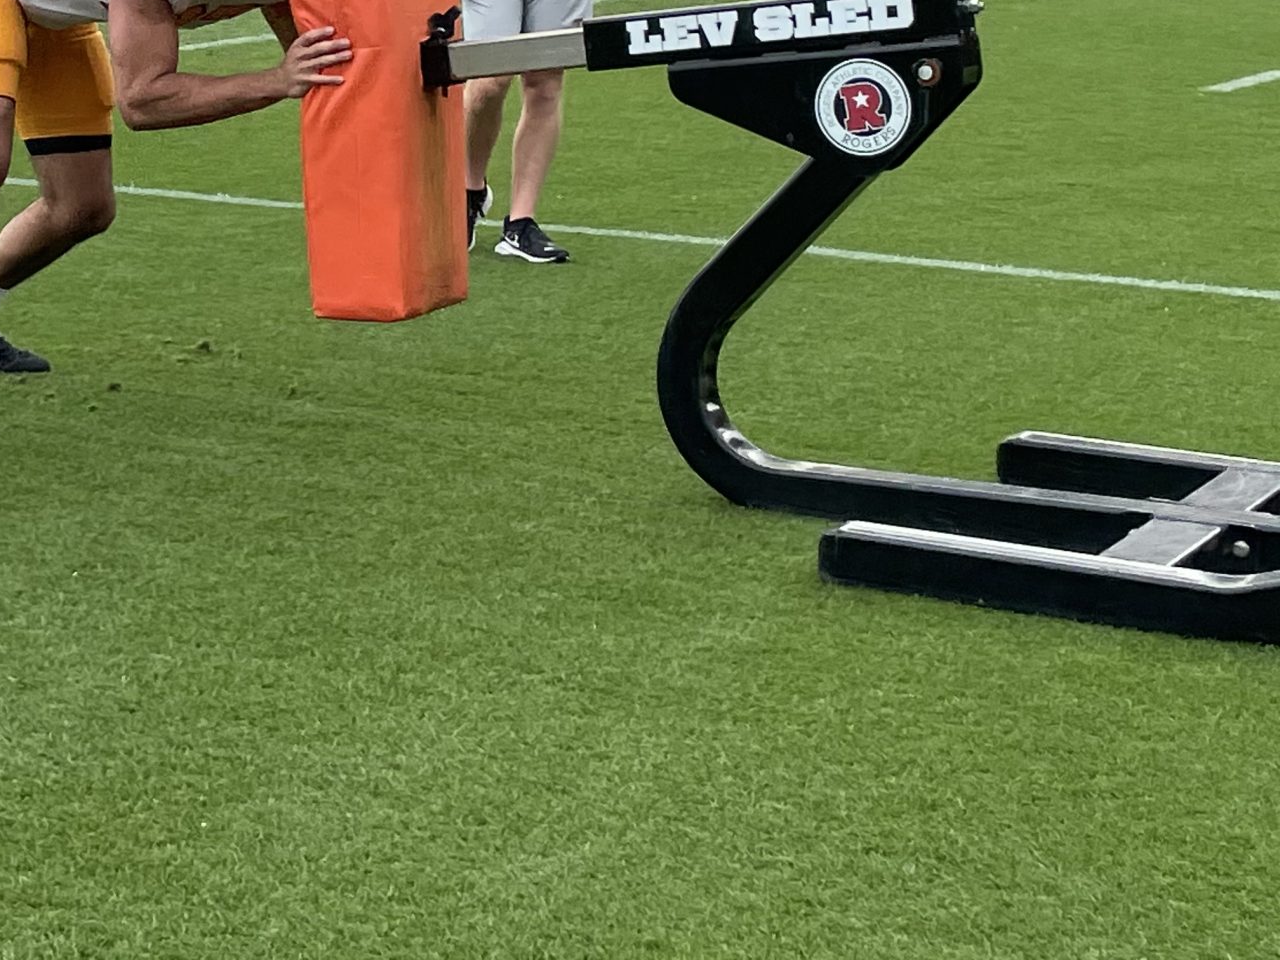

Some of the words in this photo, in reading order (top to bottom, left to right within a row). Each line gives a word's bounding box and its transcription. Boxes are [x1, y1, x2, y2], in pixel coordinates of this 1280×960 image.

[625, 10, 738, 55] LEV
[839, 82, 887, 133] R
[841, 126, 897, 149] ROGERS
